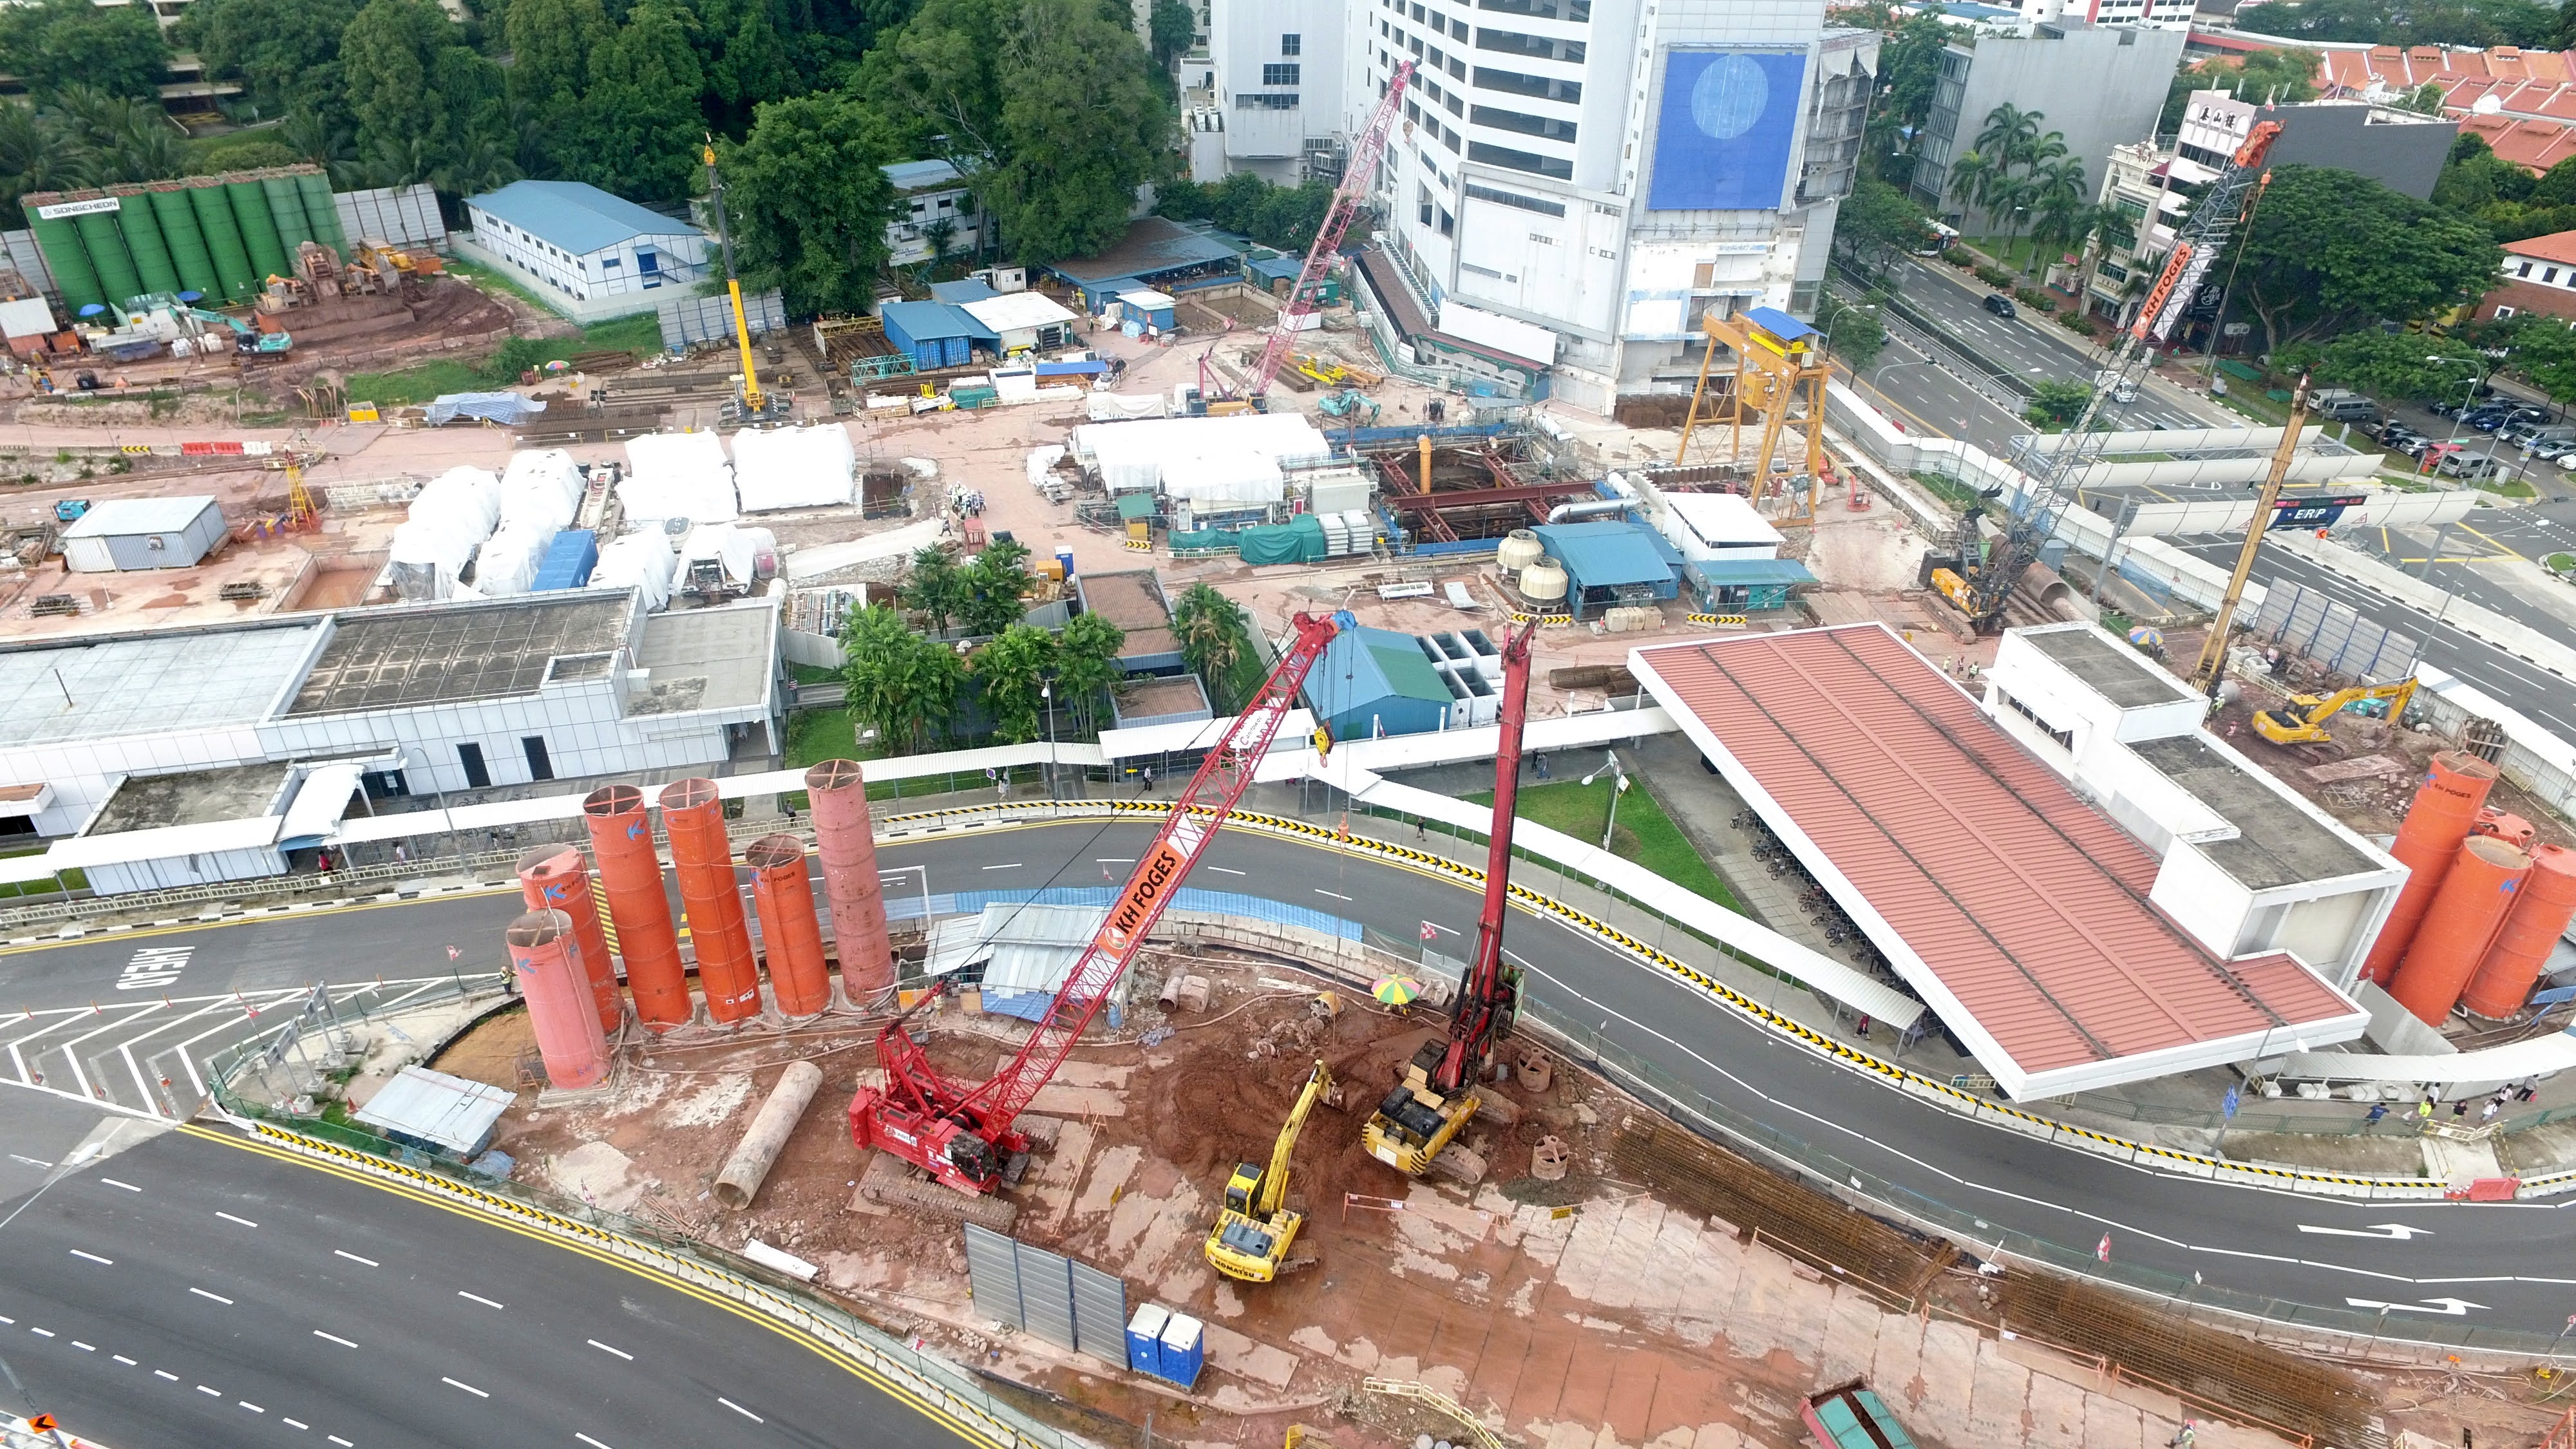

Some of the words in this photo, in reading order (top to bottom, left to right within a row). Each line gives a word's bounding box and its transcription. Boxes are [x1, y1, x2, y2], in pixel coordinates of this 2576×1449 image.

[53, 200, 117, 214] SONGCHEON
[2145, 296, 2159, 317] KH
[2157, 248, 2187, 296] FOGES
[2294, 508, 2326, 519] ERP
[773, 871, 796, 882] FOGES
[1115, 904, 1141, 934] KH
[1132, 850, 1177, 910] FOGES
[116, 946, 195, 990] AHEAD
[1215, 1259, 1255, 1278] KOMATSU
